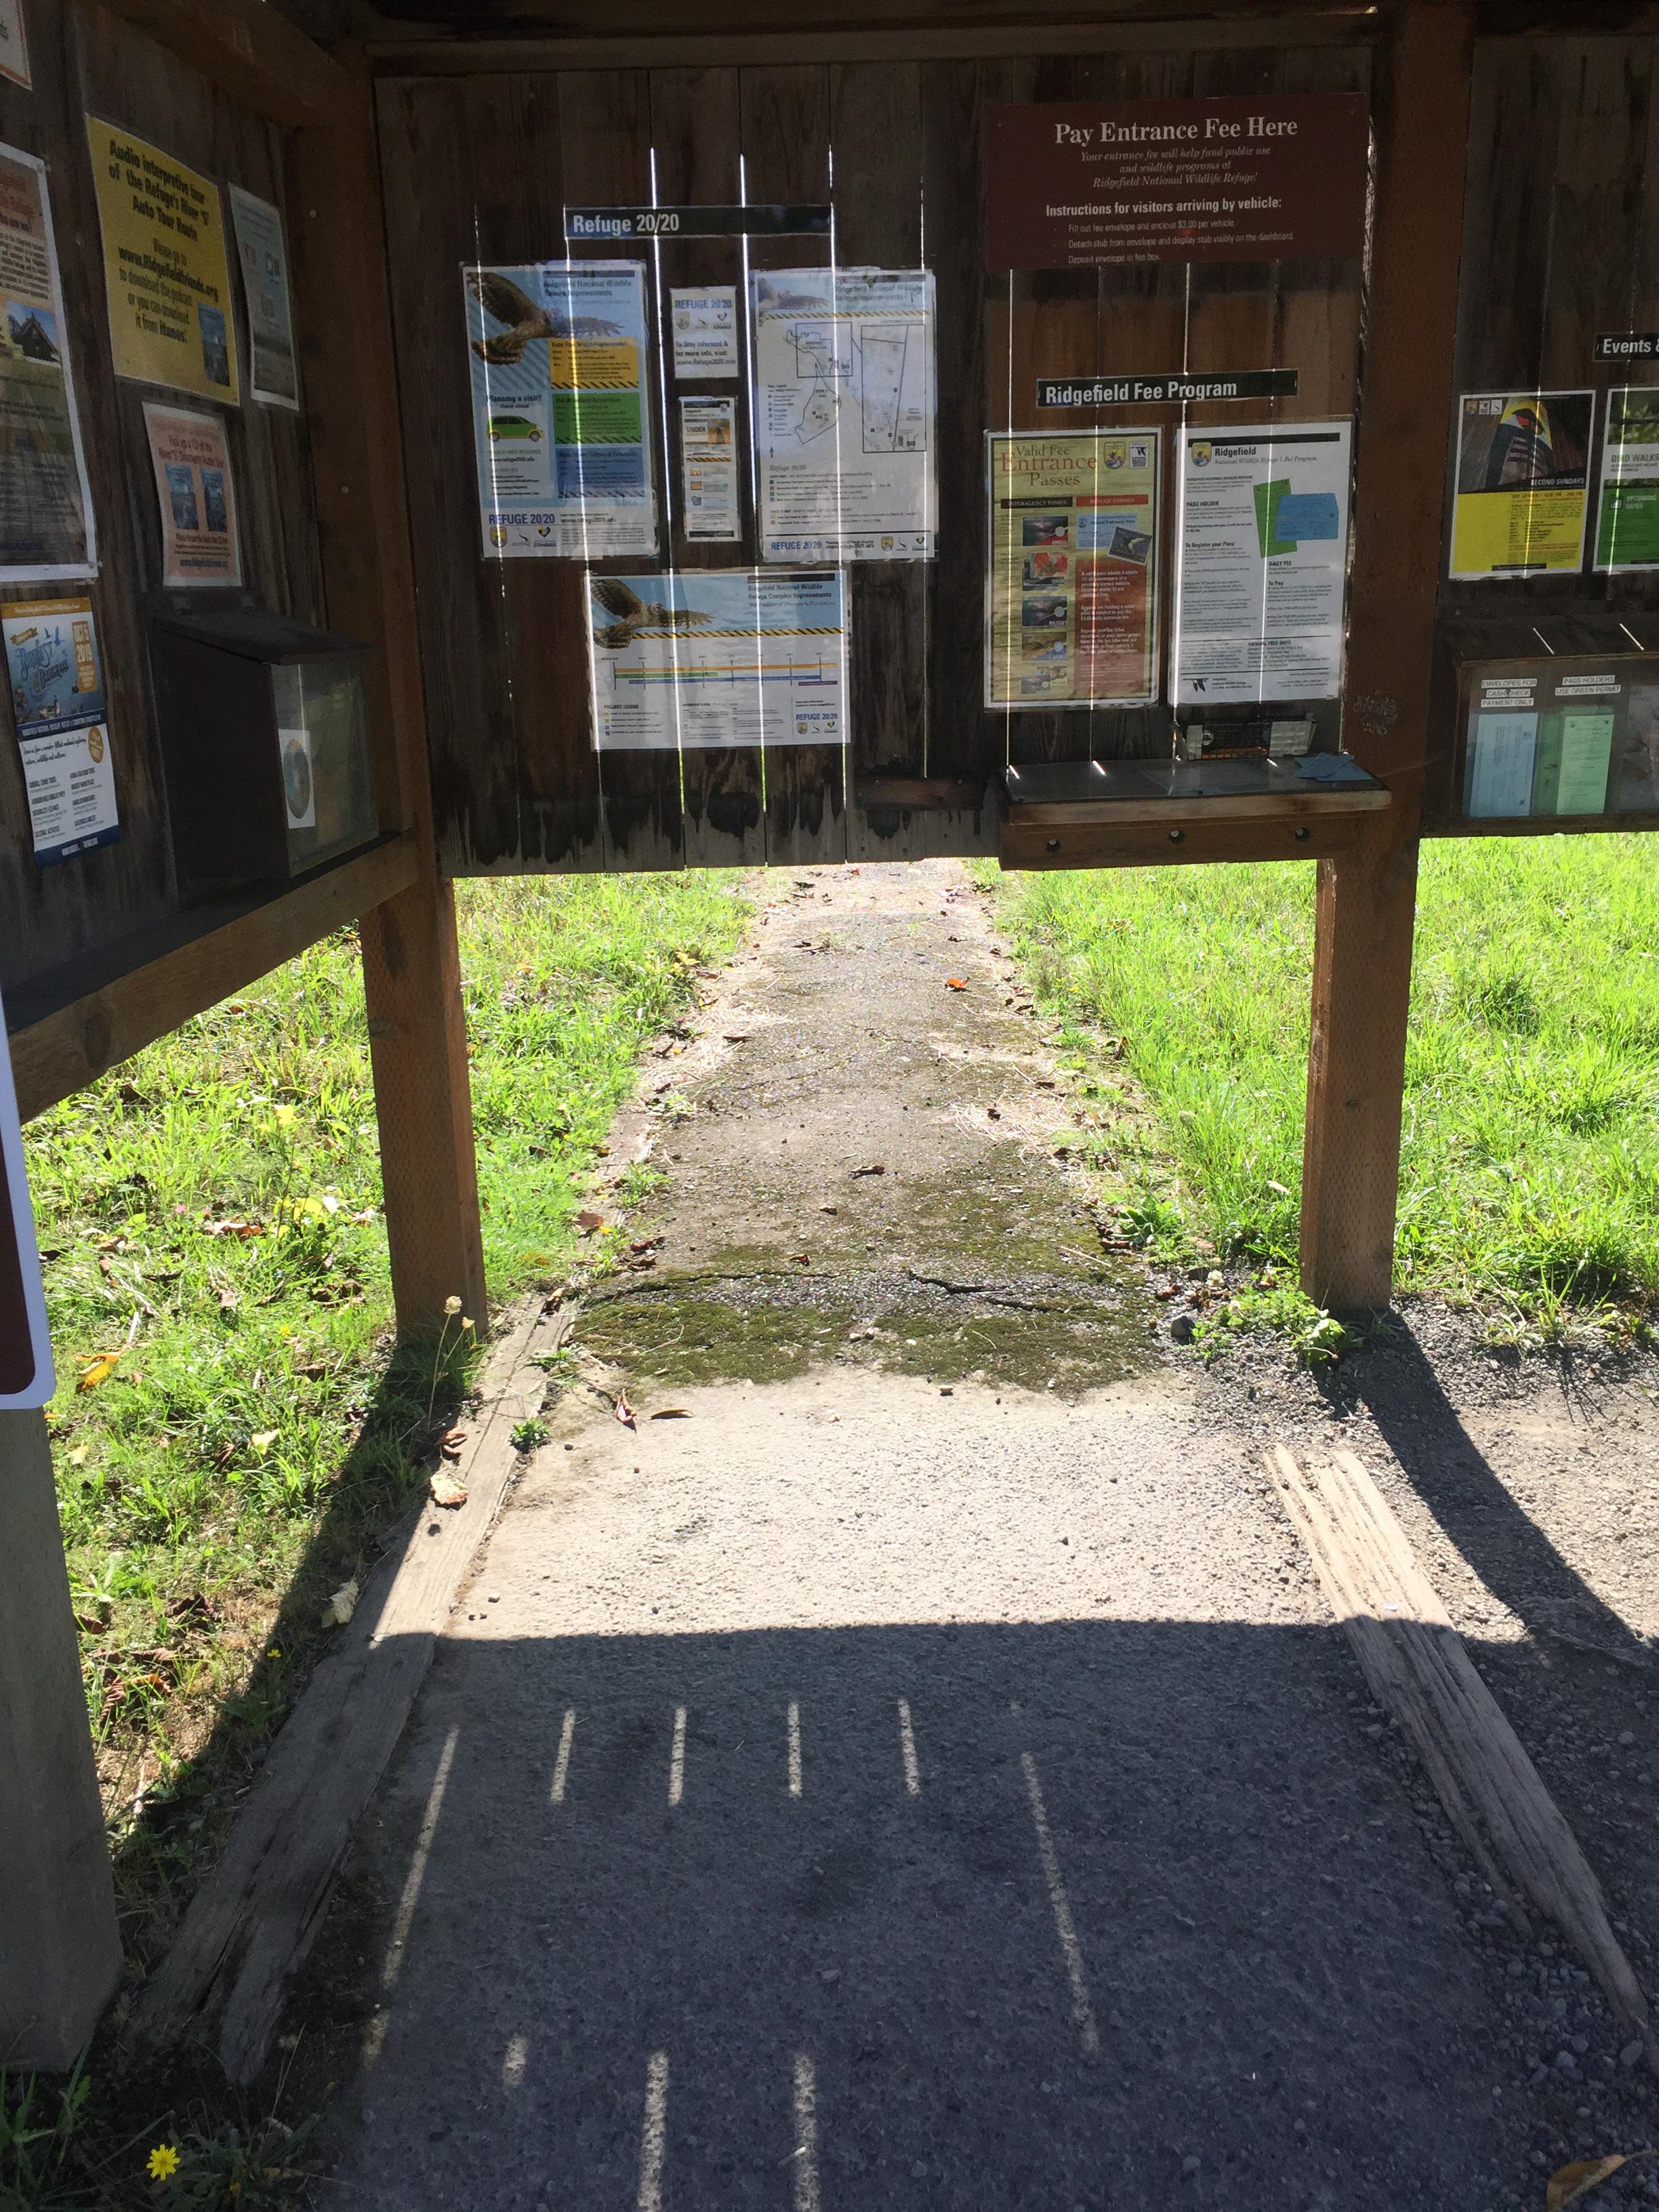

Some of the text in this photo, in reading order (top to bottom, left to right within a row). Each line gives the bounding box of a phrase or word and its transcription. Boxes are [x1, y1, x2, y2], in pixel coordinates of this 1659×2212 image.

[1054, 117, 1298, 147] Pay Entrance Fee Here
[1081, 152, 1102, 162] Your
[1105, 150, 1144, 161] entrance
[1145, 150, 1159, 161] fee
[1161, 148, 1179, 159] will
[1180, 148, 1200, 159] help
[1200, 146, 1224, 159] fund
[1225, 146, 1253, 157] public
[109, 140, 140, 168] Audio
[142, 155, 188, 195] interpretive
[1120, 161, 1232, 174] and wildlife programs at
[108, 163, 120, 180] of
[126, 169, 142, 190] the
[1092, 176, 1139, 189] Ridgefield
[1141, 174, 1183, 187] National
[1185, 172, 1221, 185] Wildlife
[133, 195, 155, 219] Auto
[156, 206, 174, 229] Tour
[1046, 196, 1282, 216] Instructions for visitors arriving by vehicle:
[573, 213, 680, 237] Refuge 20/20
[1068, 224, 1078, 232] Fill
[1080, 225, 1091, 233] out
[1105, 223, 1136, 232] envelope
[1136, 222, 1149, 230] and
[1151, 221, 1176, 230] enclose
[1178, 220, 1196, 229] $3.00
[1198, 220, 1209, 230] per
[1068, 239, 1092, 249] Detach
[1109, 238, 1125, 247] from
[1126, 237, 1156, 247] envelope
[1158, 237, 1171, 245] and
[1172, 235, 1195, 245] display
[1197, 234, 1212, 243] stub
[1213, 233, 1234, 244] visibly
[1246, 232, 1256, 241] the
[1095, 253, 1126, 264] envelope
[1127, 253, 1134, 262] in
[675, 300, 709, 309] REFUGE
[1603, 338, 1652, 354] Events
[1046, 381, 1237, 405] Ridgefield Fee Program
[1016, 444, 1070, 456] Valid Fee
[1215, 447, 1256, 457] Ridgefield
[1001, 453, 1097, 472] Entrance
[1030, 472, 1081, 486] Passes
[1556, 477, 1584, 485] SUNDAYS
[489, 514, 527, 525] REFUGE
[771, 541, 801, 550] REFUGE
